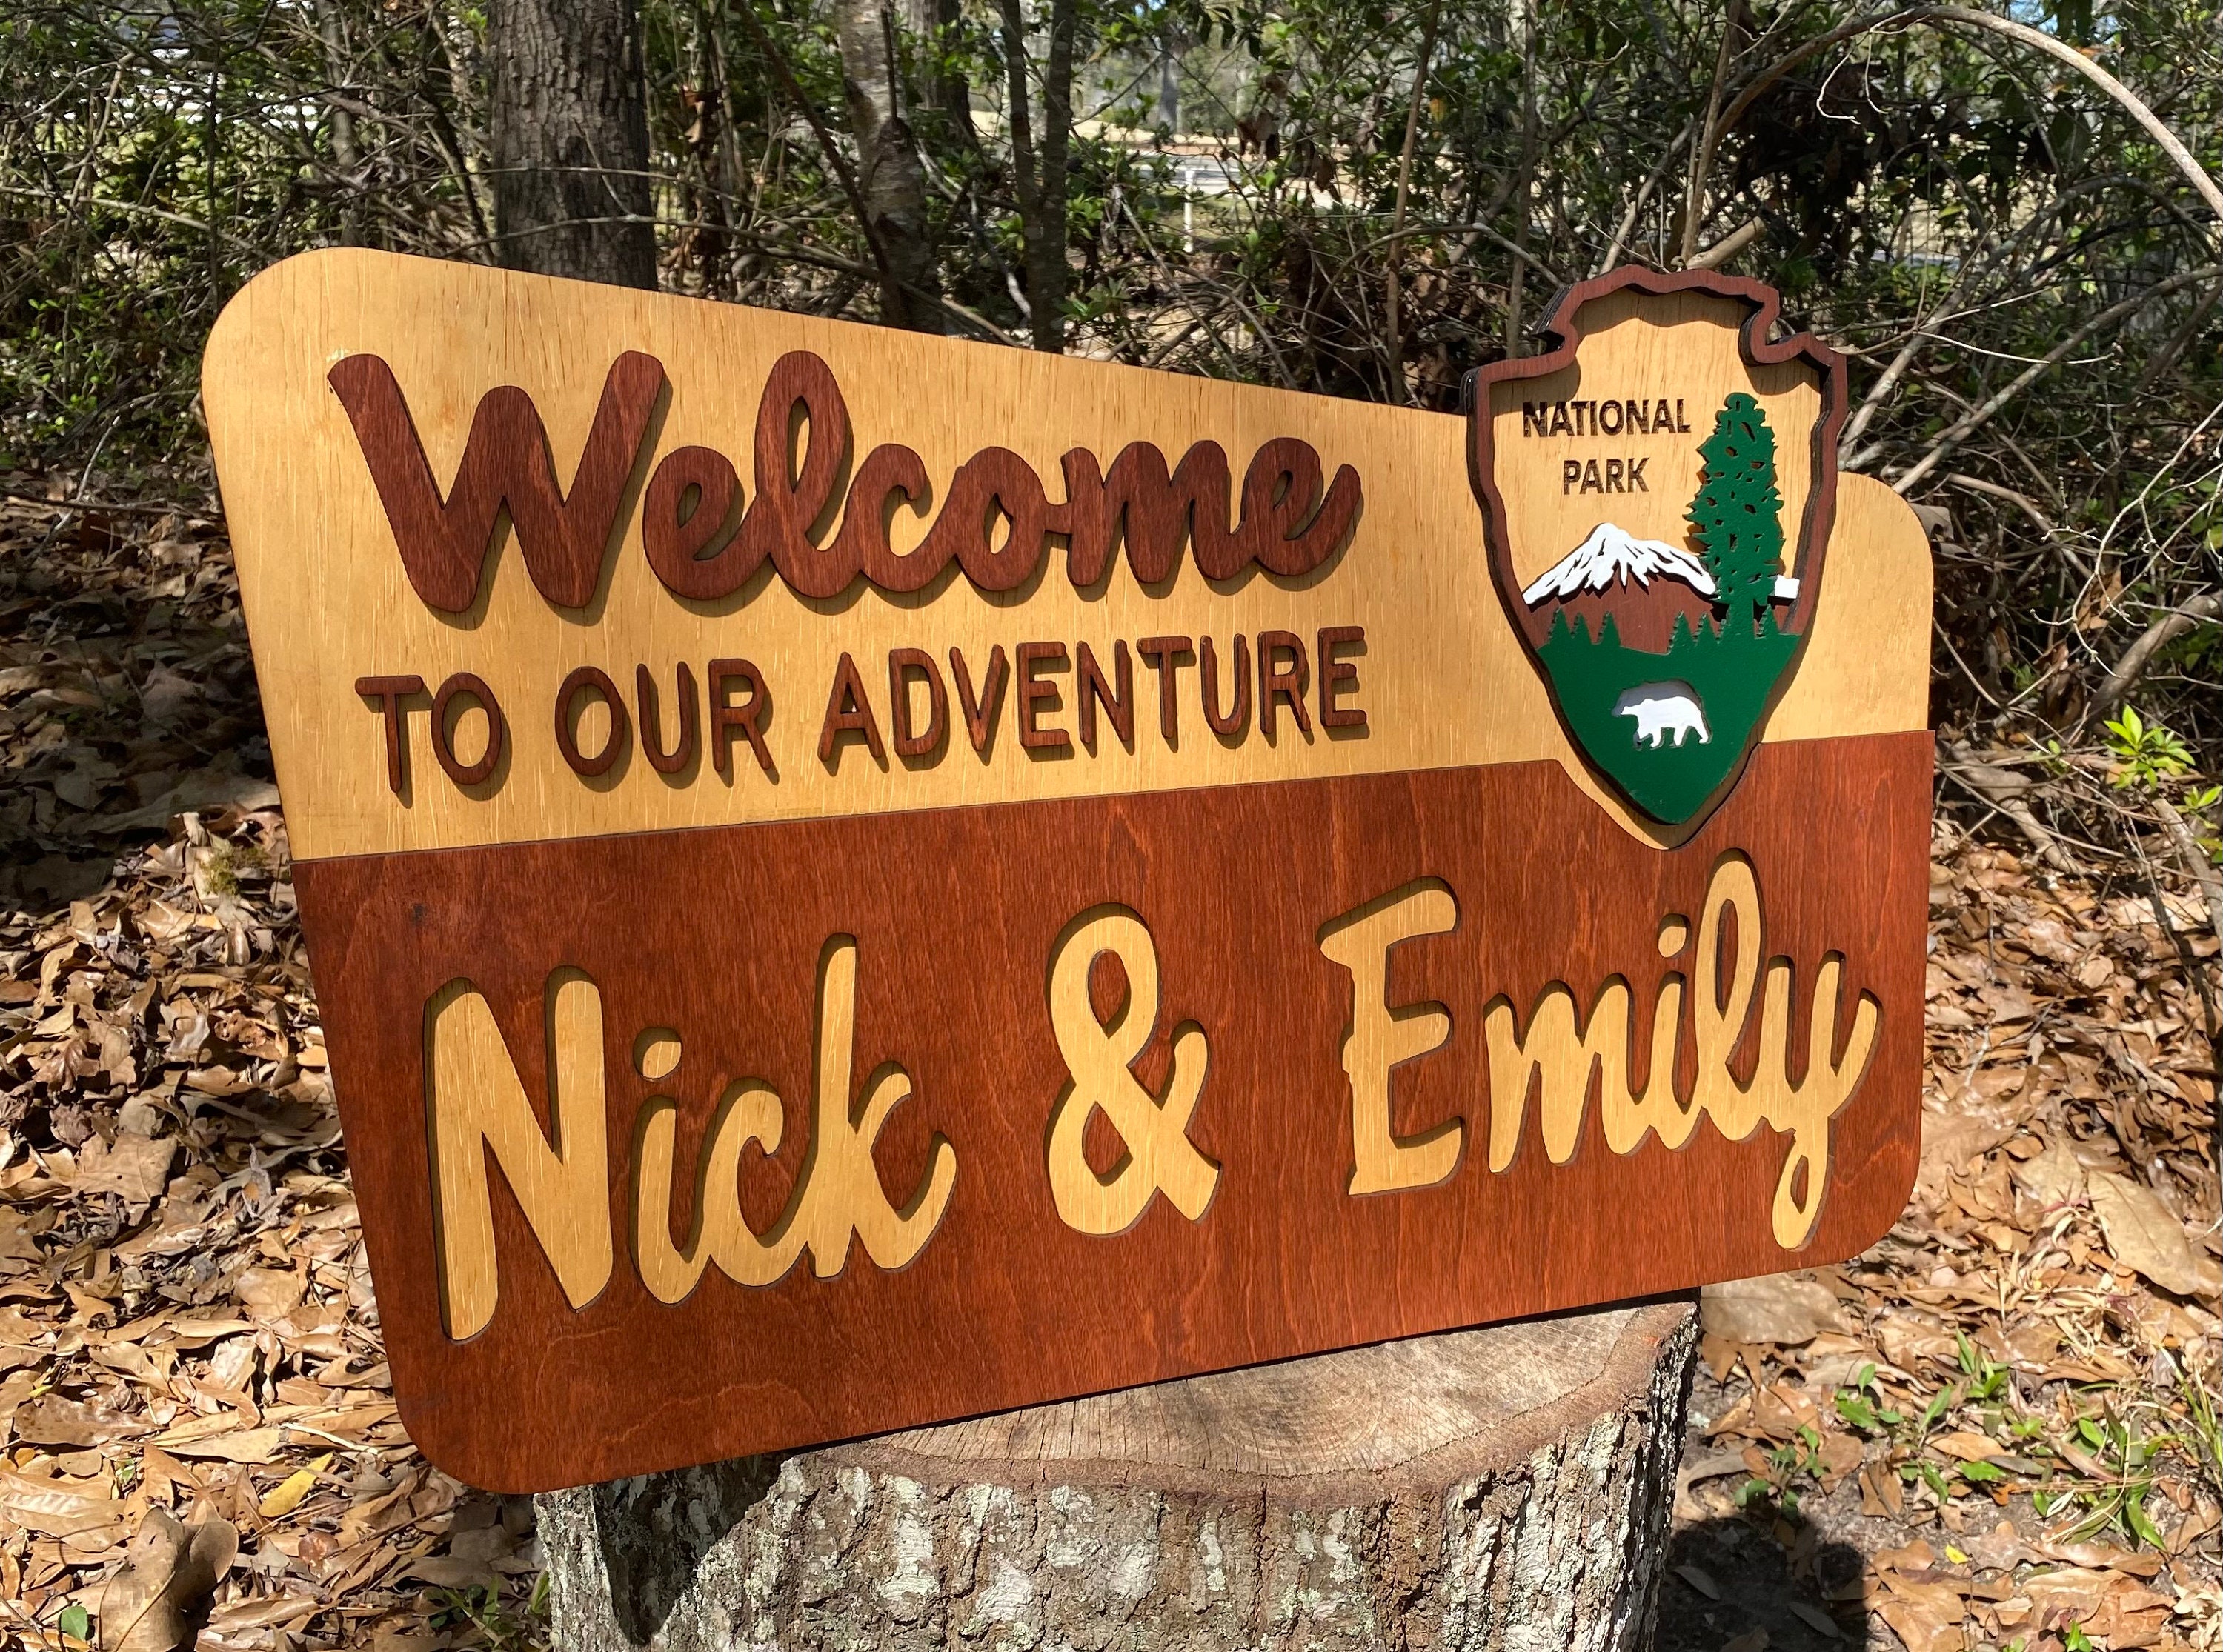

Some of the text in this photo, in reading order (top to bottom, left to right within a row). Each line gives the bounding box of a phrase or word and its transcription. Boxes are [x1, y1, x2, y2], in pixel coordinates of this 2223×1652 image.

[329, 350, 1362, 613] Welcome
[1523, 399, 1692, 439] NATIONAL
[1564, 458, 1650, 496] PARK
[355, 626, 1368, 793] TO OUR ADVENTURE
[425, 848, 1879, 1342] Nick & Emily
